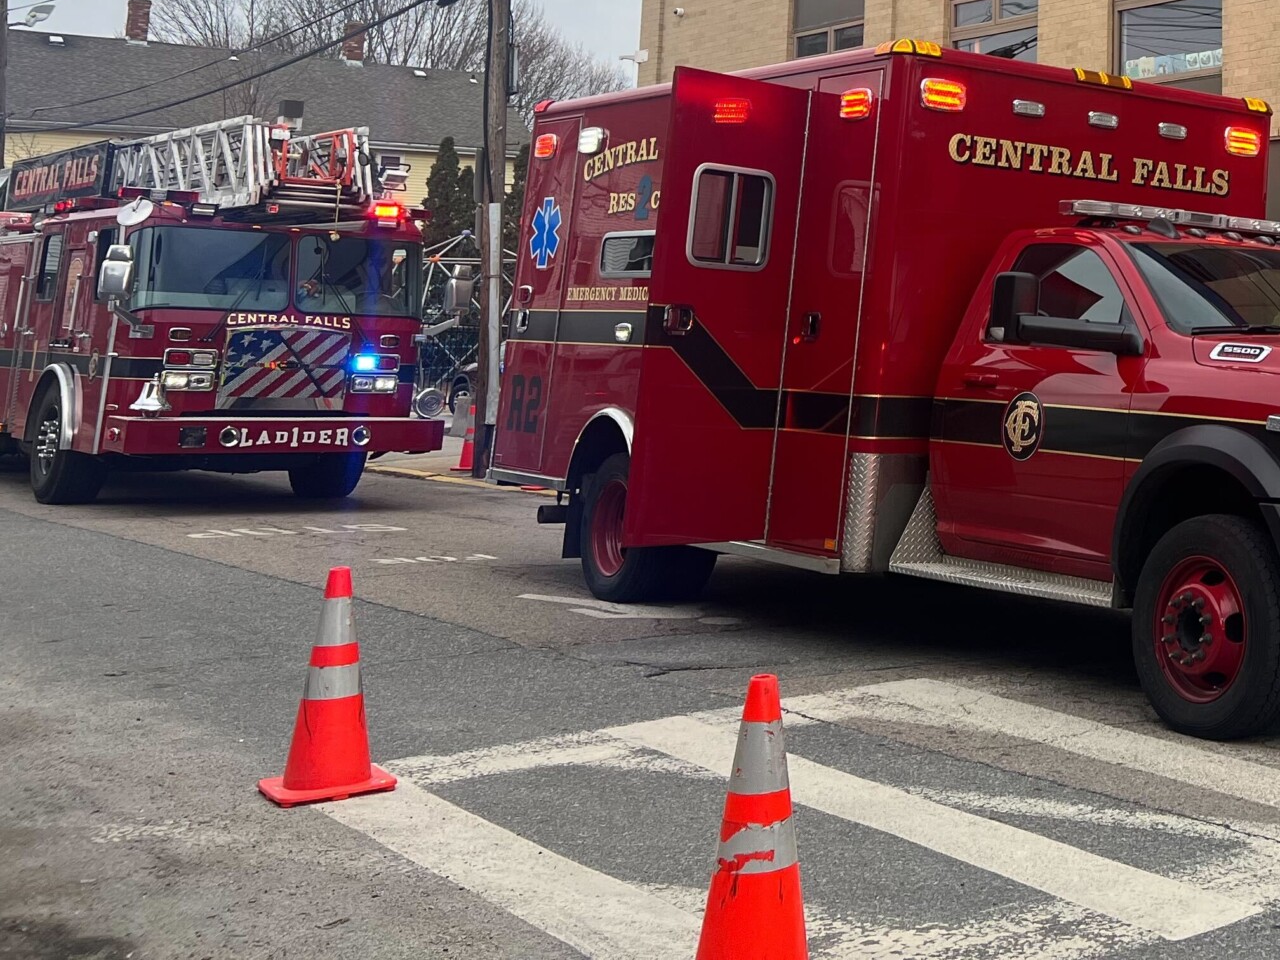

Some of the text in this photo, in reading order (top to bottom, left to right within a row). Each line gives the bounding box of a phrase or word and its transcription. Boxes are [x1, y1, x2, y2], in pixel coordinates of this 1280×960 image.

[583, 137, 659, 182] CENTRAL
[948, 132, 1230, 196] CENTRAL FALLS
[14, 154, 100, 197] CENTRAL FALLS
[566, 286, 617, 301] EMERGENCY
[227, 313, 351, 329] CENTRAL FALLS
[1223, 346, 1261, 355] 5500
[507, 374, 542, 433] R2
[186, 523, 409, 539] STOP
[368, 553, 499, 565] FOR
